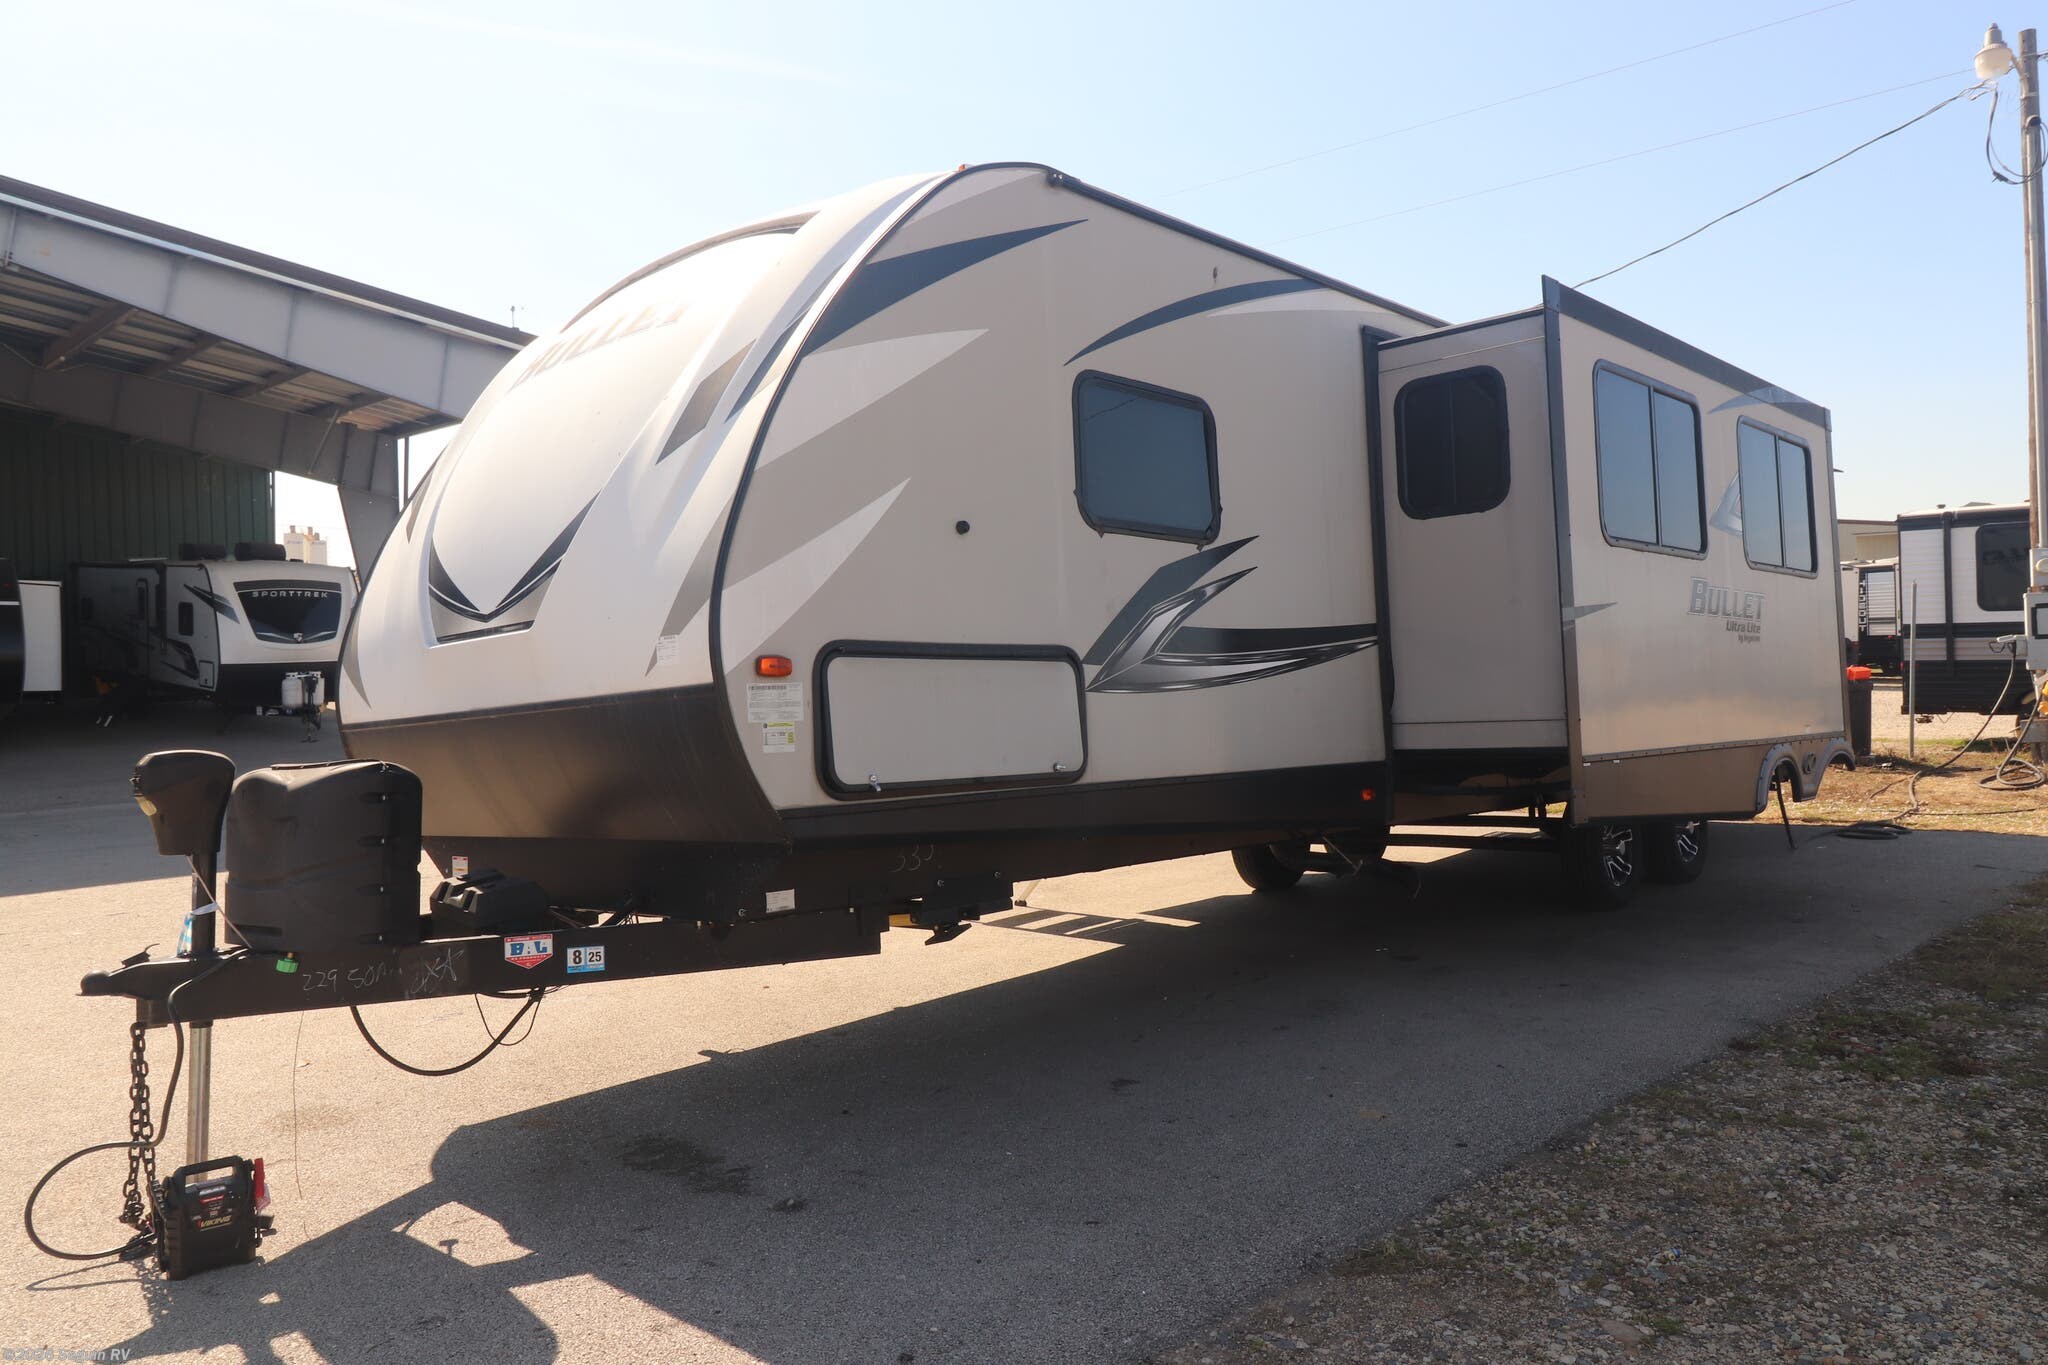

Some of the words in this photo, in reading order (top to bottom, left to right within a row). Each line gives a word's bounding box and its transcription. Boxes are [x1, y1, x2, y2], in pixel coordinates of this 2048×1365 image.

[251, 590, 329, 598] SPORTTREK
[1687, 576, 1768, 622] BULLET
[1726, 619, 1745, 632] Ultra
[1747, 622, 1760, 634] Lite
[572, 949, 582, 965] 8
[588, 951, 602, 963] 25
[199, 1214, 232, 1228] VIKING
